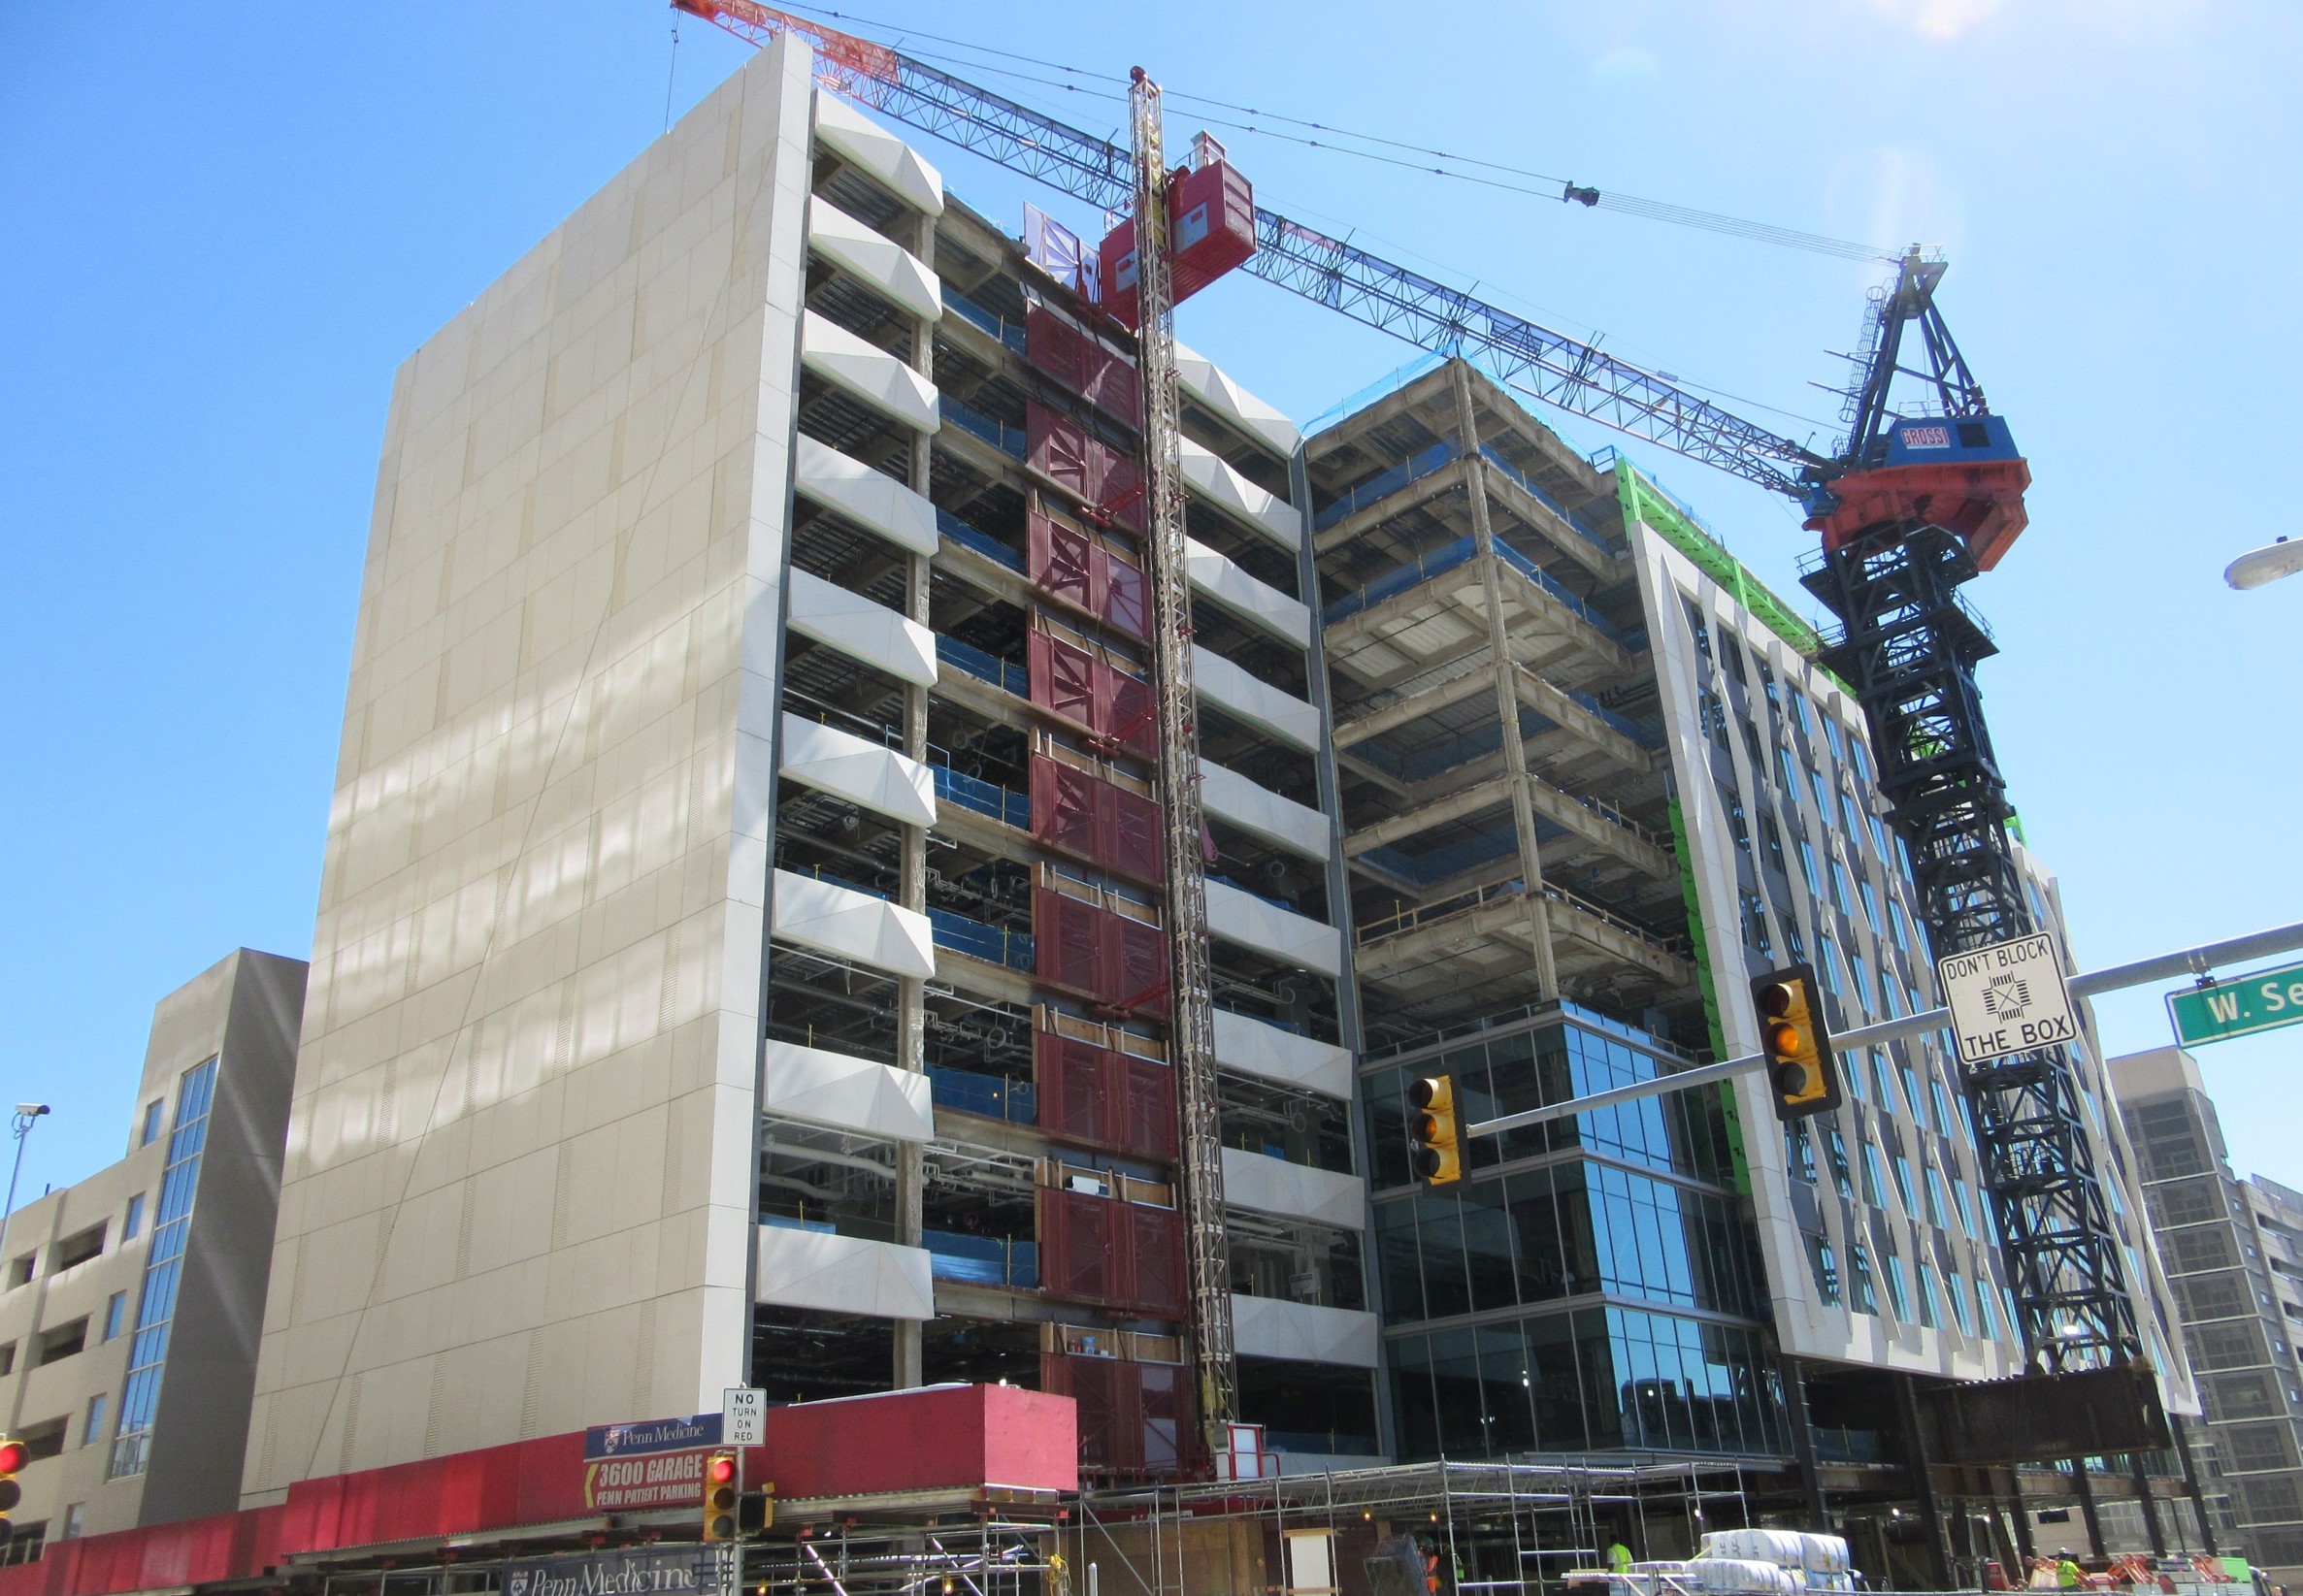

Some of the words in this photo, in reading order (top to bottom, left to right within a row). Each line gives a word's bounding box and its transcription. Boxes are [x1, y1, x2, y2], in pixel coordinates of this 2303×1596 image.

[1901, 428, 1949, 445] GROSSI
[1946, 953, 1990, 980] DON'T
[1996, 939, 2049, 967] BLOCK
[2207, 992, 2252, 1024] W.
[1964, 1028, 2011, 1057] THE
[2021, 1016, 2070, 1045] BOX
[735, 1393, 754, 1405] NO
[733, 1407, 757, 1417] TURN
[737, 1419, 751, 1429] ON
[623, 1429, 652, 1446] Penn
[654, 1422, 705, 1443] Medicine
[734, 1431, 753, 1442] RED
[599, 1460, 643, 1487] 3600
[646, 1454, 703, 1483] GARAGE
[596, 1489, 622, 1507] PENN
[624, 1484, 659, 1504] PATIENT
[660, 1482, 701, 1501] PARKING
[531, 1569, 577, 1596] Penn
